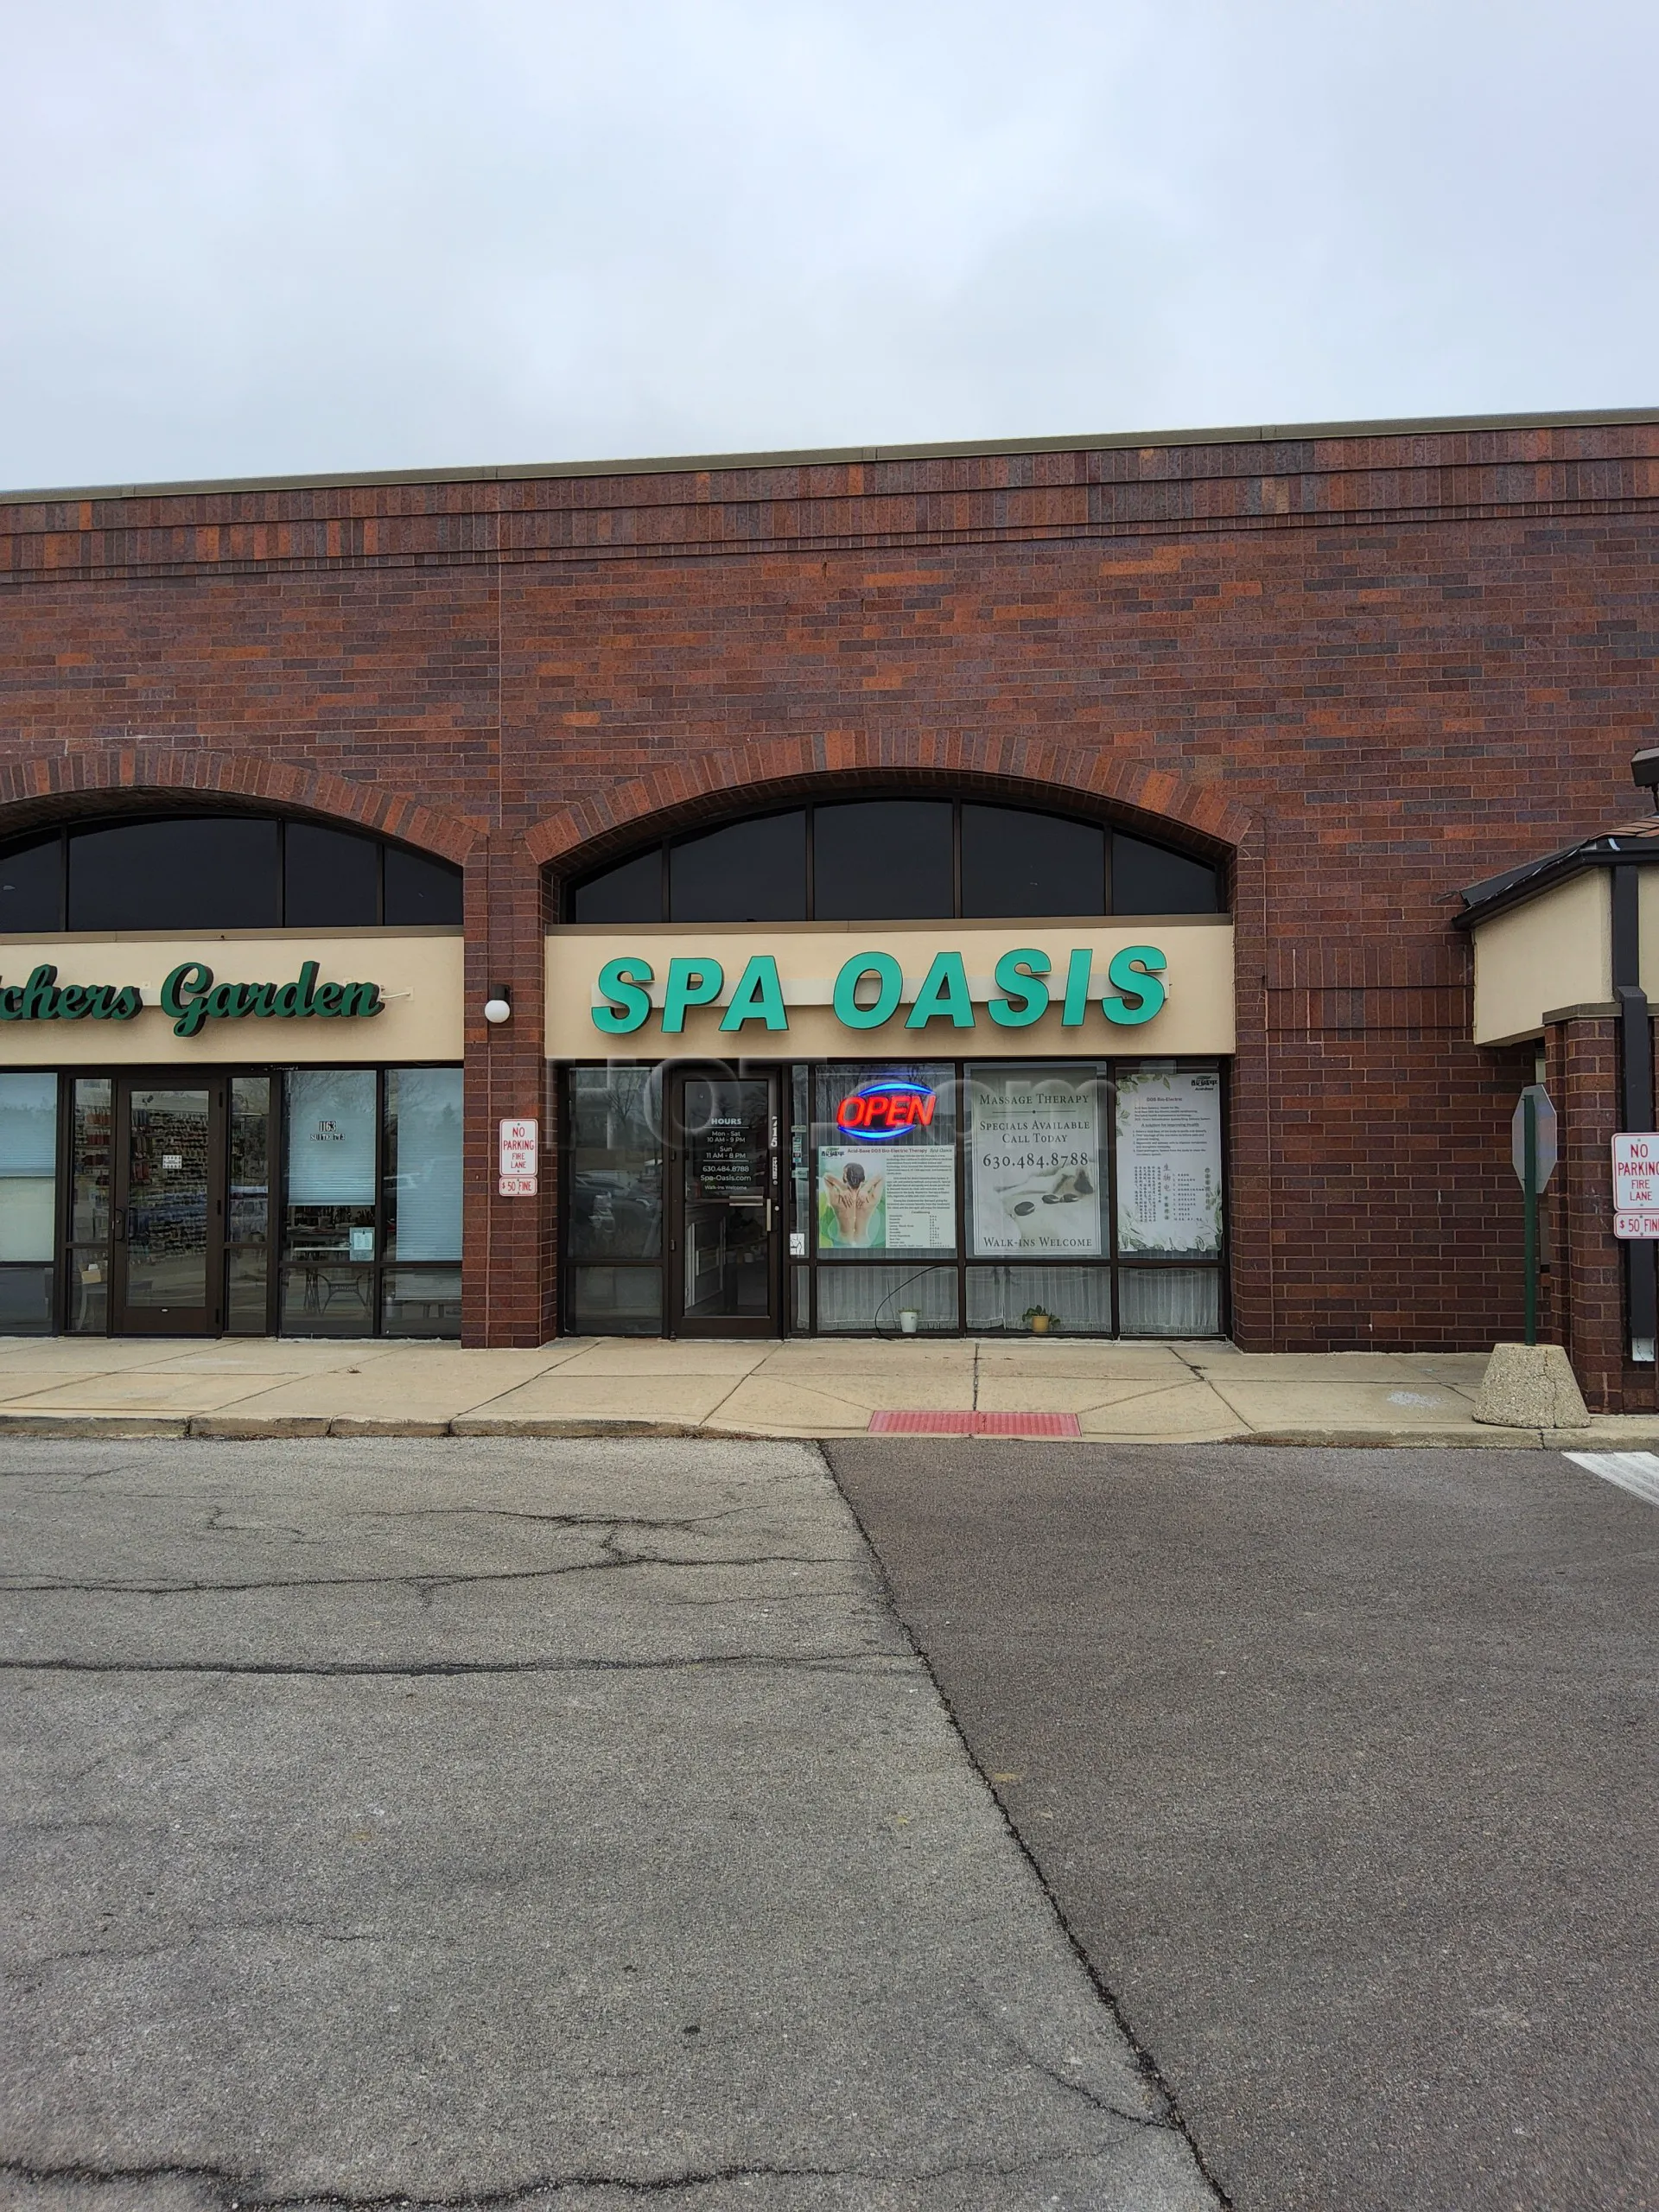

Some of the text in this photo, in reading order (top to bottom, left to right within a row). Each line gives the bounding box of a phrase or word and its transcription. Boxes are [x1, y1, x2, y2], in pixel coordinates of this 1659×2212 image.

[591, 944, 1168, 1034] SPA OASIS
[0, 960, 386, 1037] chers Garden
[836, 1096, 937, 1127] OPEN
[319, 1121, 337, 1132] 1163
[512, 1127, 525, 1138] NO
[503, 1140, 534, 1151] PARKING
[1630, 1143, 1649, 1159] NO
[512, 1152, 525, 1160] FIRE
[982, 1152, 1089, 1170] 630.484.8788
[511, 1160, 527, 1169] LANE
[518, 1180, 532, 1192] FINE
[1631, 1179, 1650, 1190] FIRE
[1630, 1192, 1652, 1202] LANE
